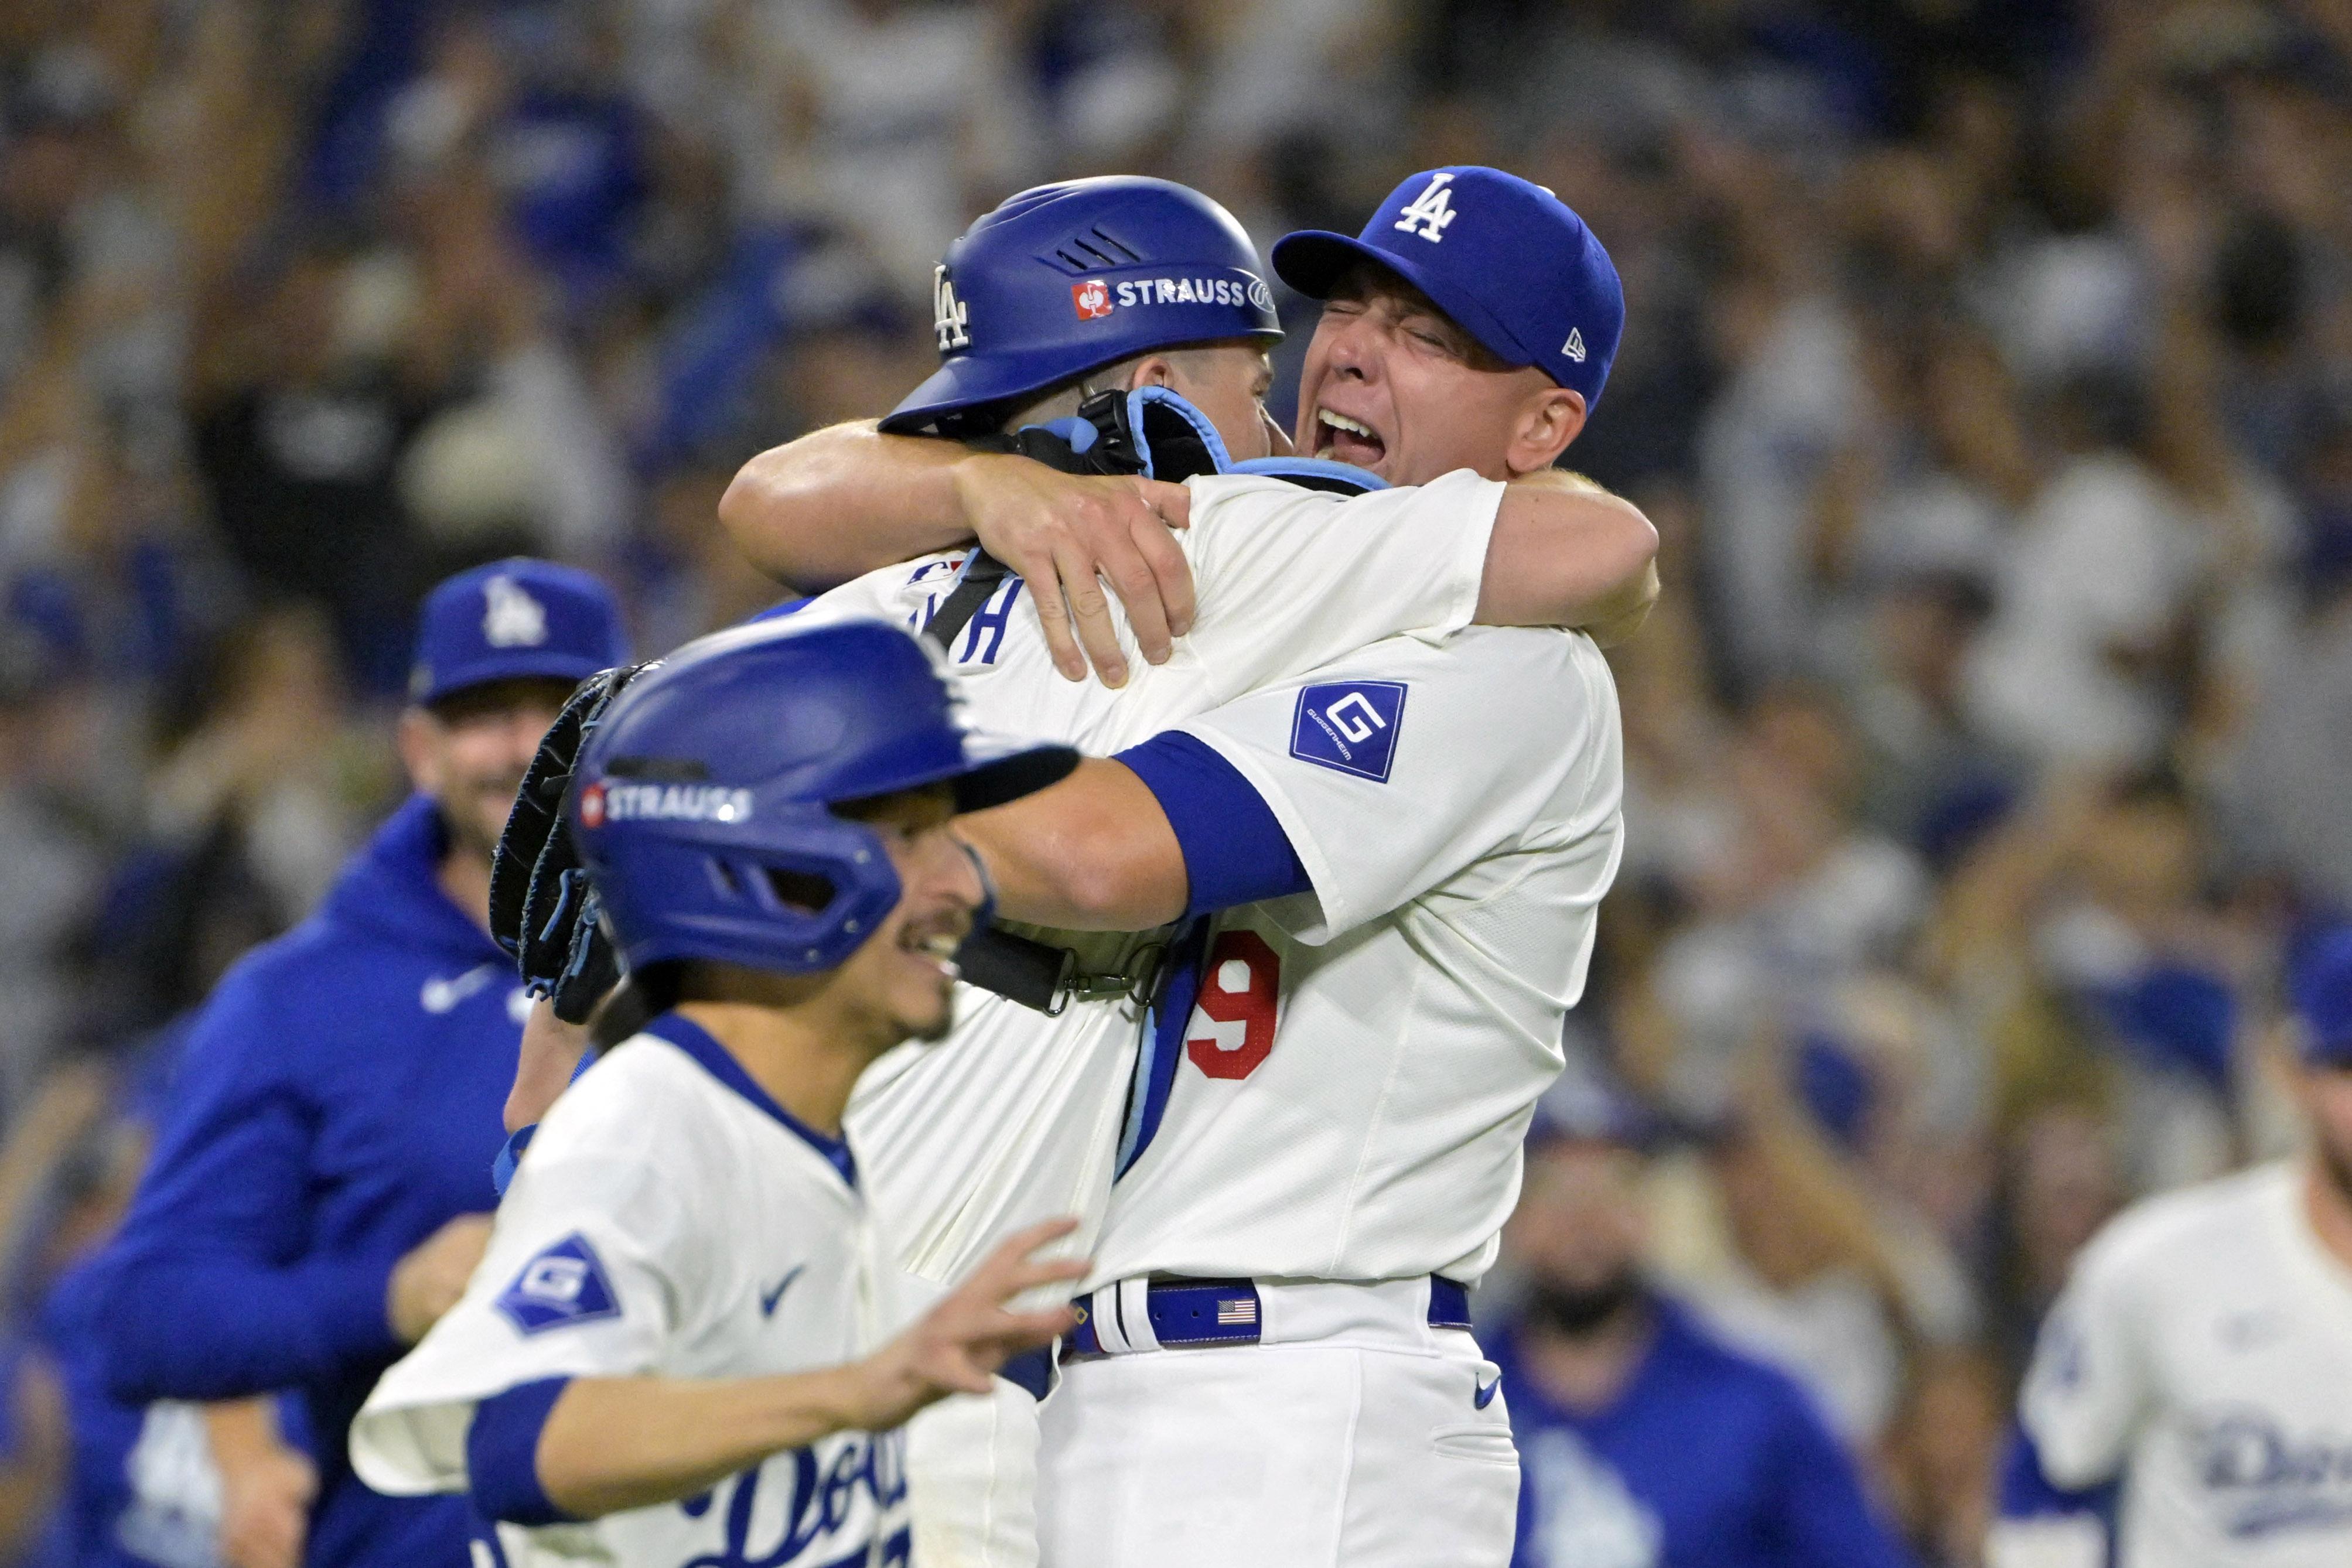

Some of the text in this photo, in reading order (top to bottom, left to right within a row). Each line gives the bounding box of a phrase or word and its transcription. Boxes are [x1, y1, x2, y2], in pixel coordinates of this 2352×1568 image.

[1394, 173, 1457, 243] LA
[933, 265, 969, 351] LA
[1117, 278, 1245, 307] STRAUSS
[1306, 708, 1352, 761] GUGGENHEIM
[1326, 692, 1387, 743] G
[606, 785, 753, 822] STRAUSS
[1187, 930, 1280, 1080] 9
